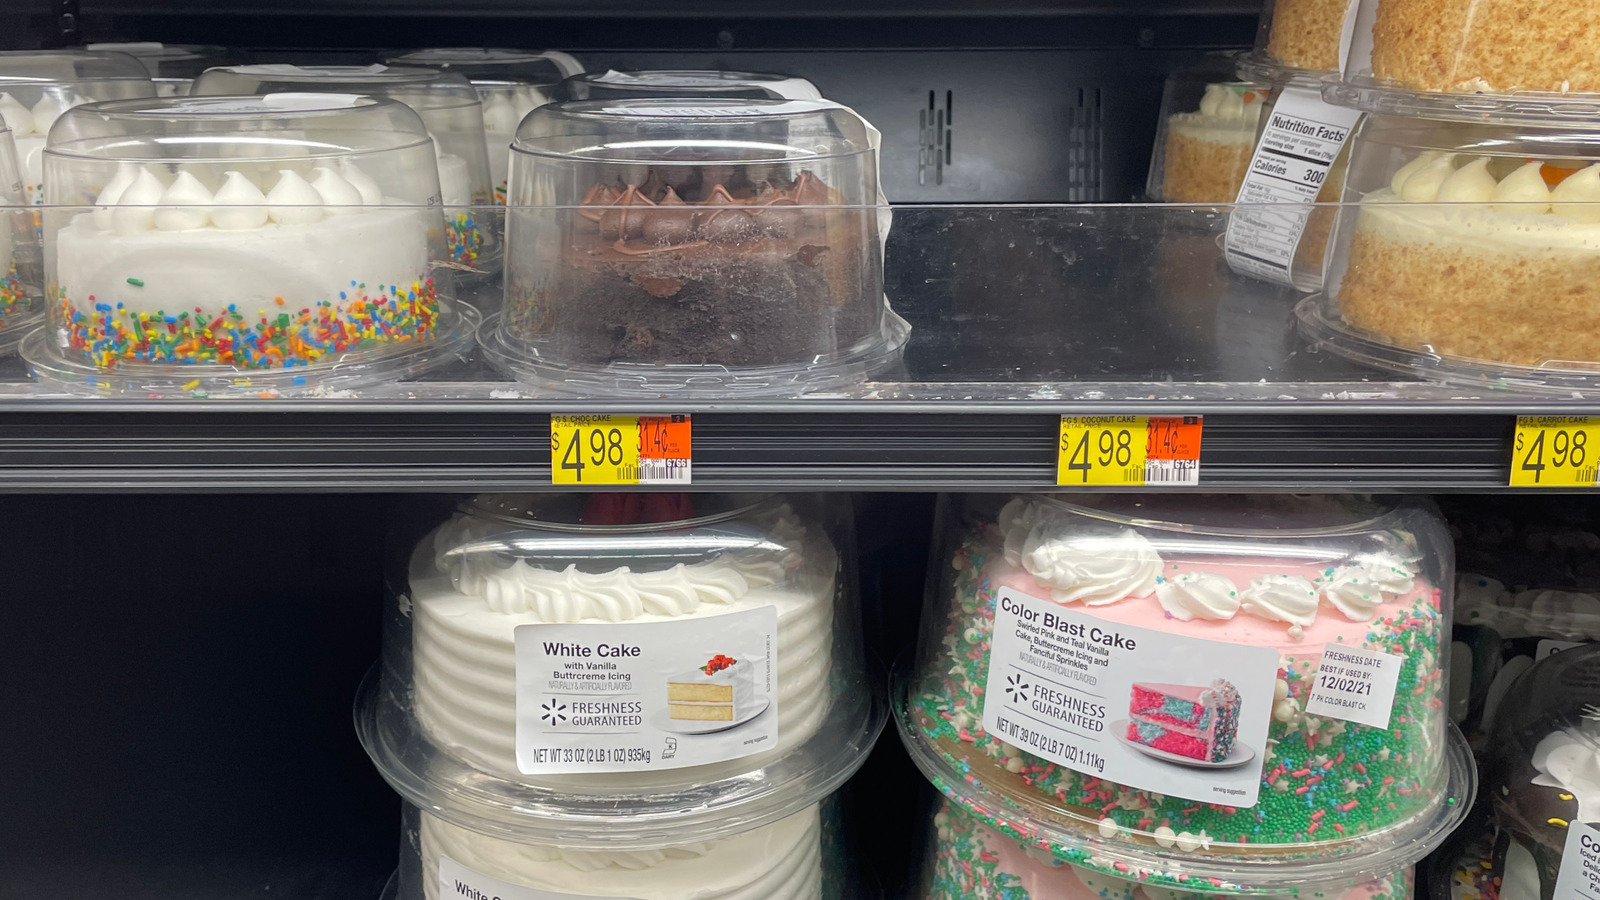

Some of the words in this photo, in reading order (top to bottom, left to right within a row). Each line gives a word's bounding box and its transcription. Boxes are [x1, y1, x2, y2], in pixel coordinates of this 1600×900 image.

[1272, 116, 1315, 135] Nutrition
[1316, 126, 1344, 141] Facts
[1264, 138, 1283, 149] Serving
[1255, 160, 1287, 174] Calories
[1304, 169, 1324, 183] 300
[667, 458, 686, 467] 6766
[1175, 459, 1195, 469] 6764
[1002, 597, 1040, 622] Color
[1043, 612, 1085, 638] Blast
[1090, 628, 1136, 650] Cake
[1017, 620, 1039, 634] Swirled
[1041, 628, 1055, 640] Pink
[1056, 634, 1070, 644] and
[1071, 638, 1085, 649] Teal
[1086, 643, 1109, 656] Vanilla
[543, 642, 591, 657] White
[597, 644, 641, 657] Cake
[1016, 630, 1032, 644] Cake,
[1034, 637, 1074, 656] Buttercreme
[1076, 650, 1093, 664] Icing
[1094, 658, 1108, 667] and
[1030, 644, 1055, 660] Fanciful
[1056, 654, 1088, 671] Sprinkles
[1325, 651, 1363, 664] FRESHNESS
[1364, 658, 1382, 668] DATE
[554, 671, 605, 680] Buttrcreme
[609, 673, 631, 681] Icing
[1320, 665, 1337, 673] BEST
[1346, 669, 1360, 678] USED
[1362, 672, 1372, 680] BY:
[1321, 675, 1371, 695] 12/02/21
[572, 702, 642, 714] FRESHNESS
[1034, 685, 1106, 719] FRESHNESS
[1325, 696, 1342, 705] COLOR
[1342, 700, 1358, 708] BLAST
[572, 715, 642, 726] GUARANTEED
[1032, 700, 1104, 732] GUARANTEED
[996, 716, 1009, 732] NET
[1010, 723, 1020, 738] WT
[1020, 727, 1028, 742] 39
[1030, 732, 1039, 747] OZ
[1040, 735, 1047, 751] (2
[1048, 738, 1058, 754] LB
[1059, 743, 1064, 756] 7
[1065, 745, 1077, 763] OZ)
[1080, 750, 1104, 773] 1.11kg
[534, 749, 548, 763] NET
[550, 748, 561, 762] WT
[564, 749, 573, 762] 33
[575, 749, 584, 762] OZ
[587, 748, 594, 764] (2
[596, 749, 605, 762] LB
[607, 749, 611, 762] 1
[614, 748, 626, 764] OZ)
[628, 748, 650, 763] 935kg
[1580, 848, 1596, 861] Iced
[455, 880, 488, 900] White
